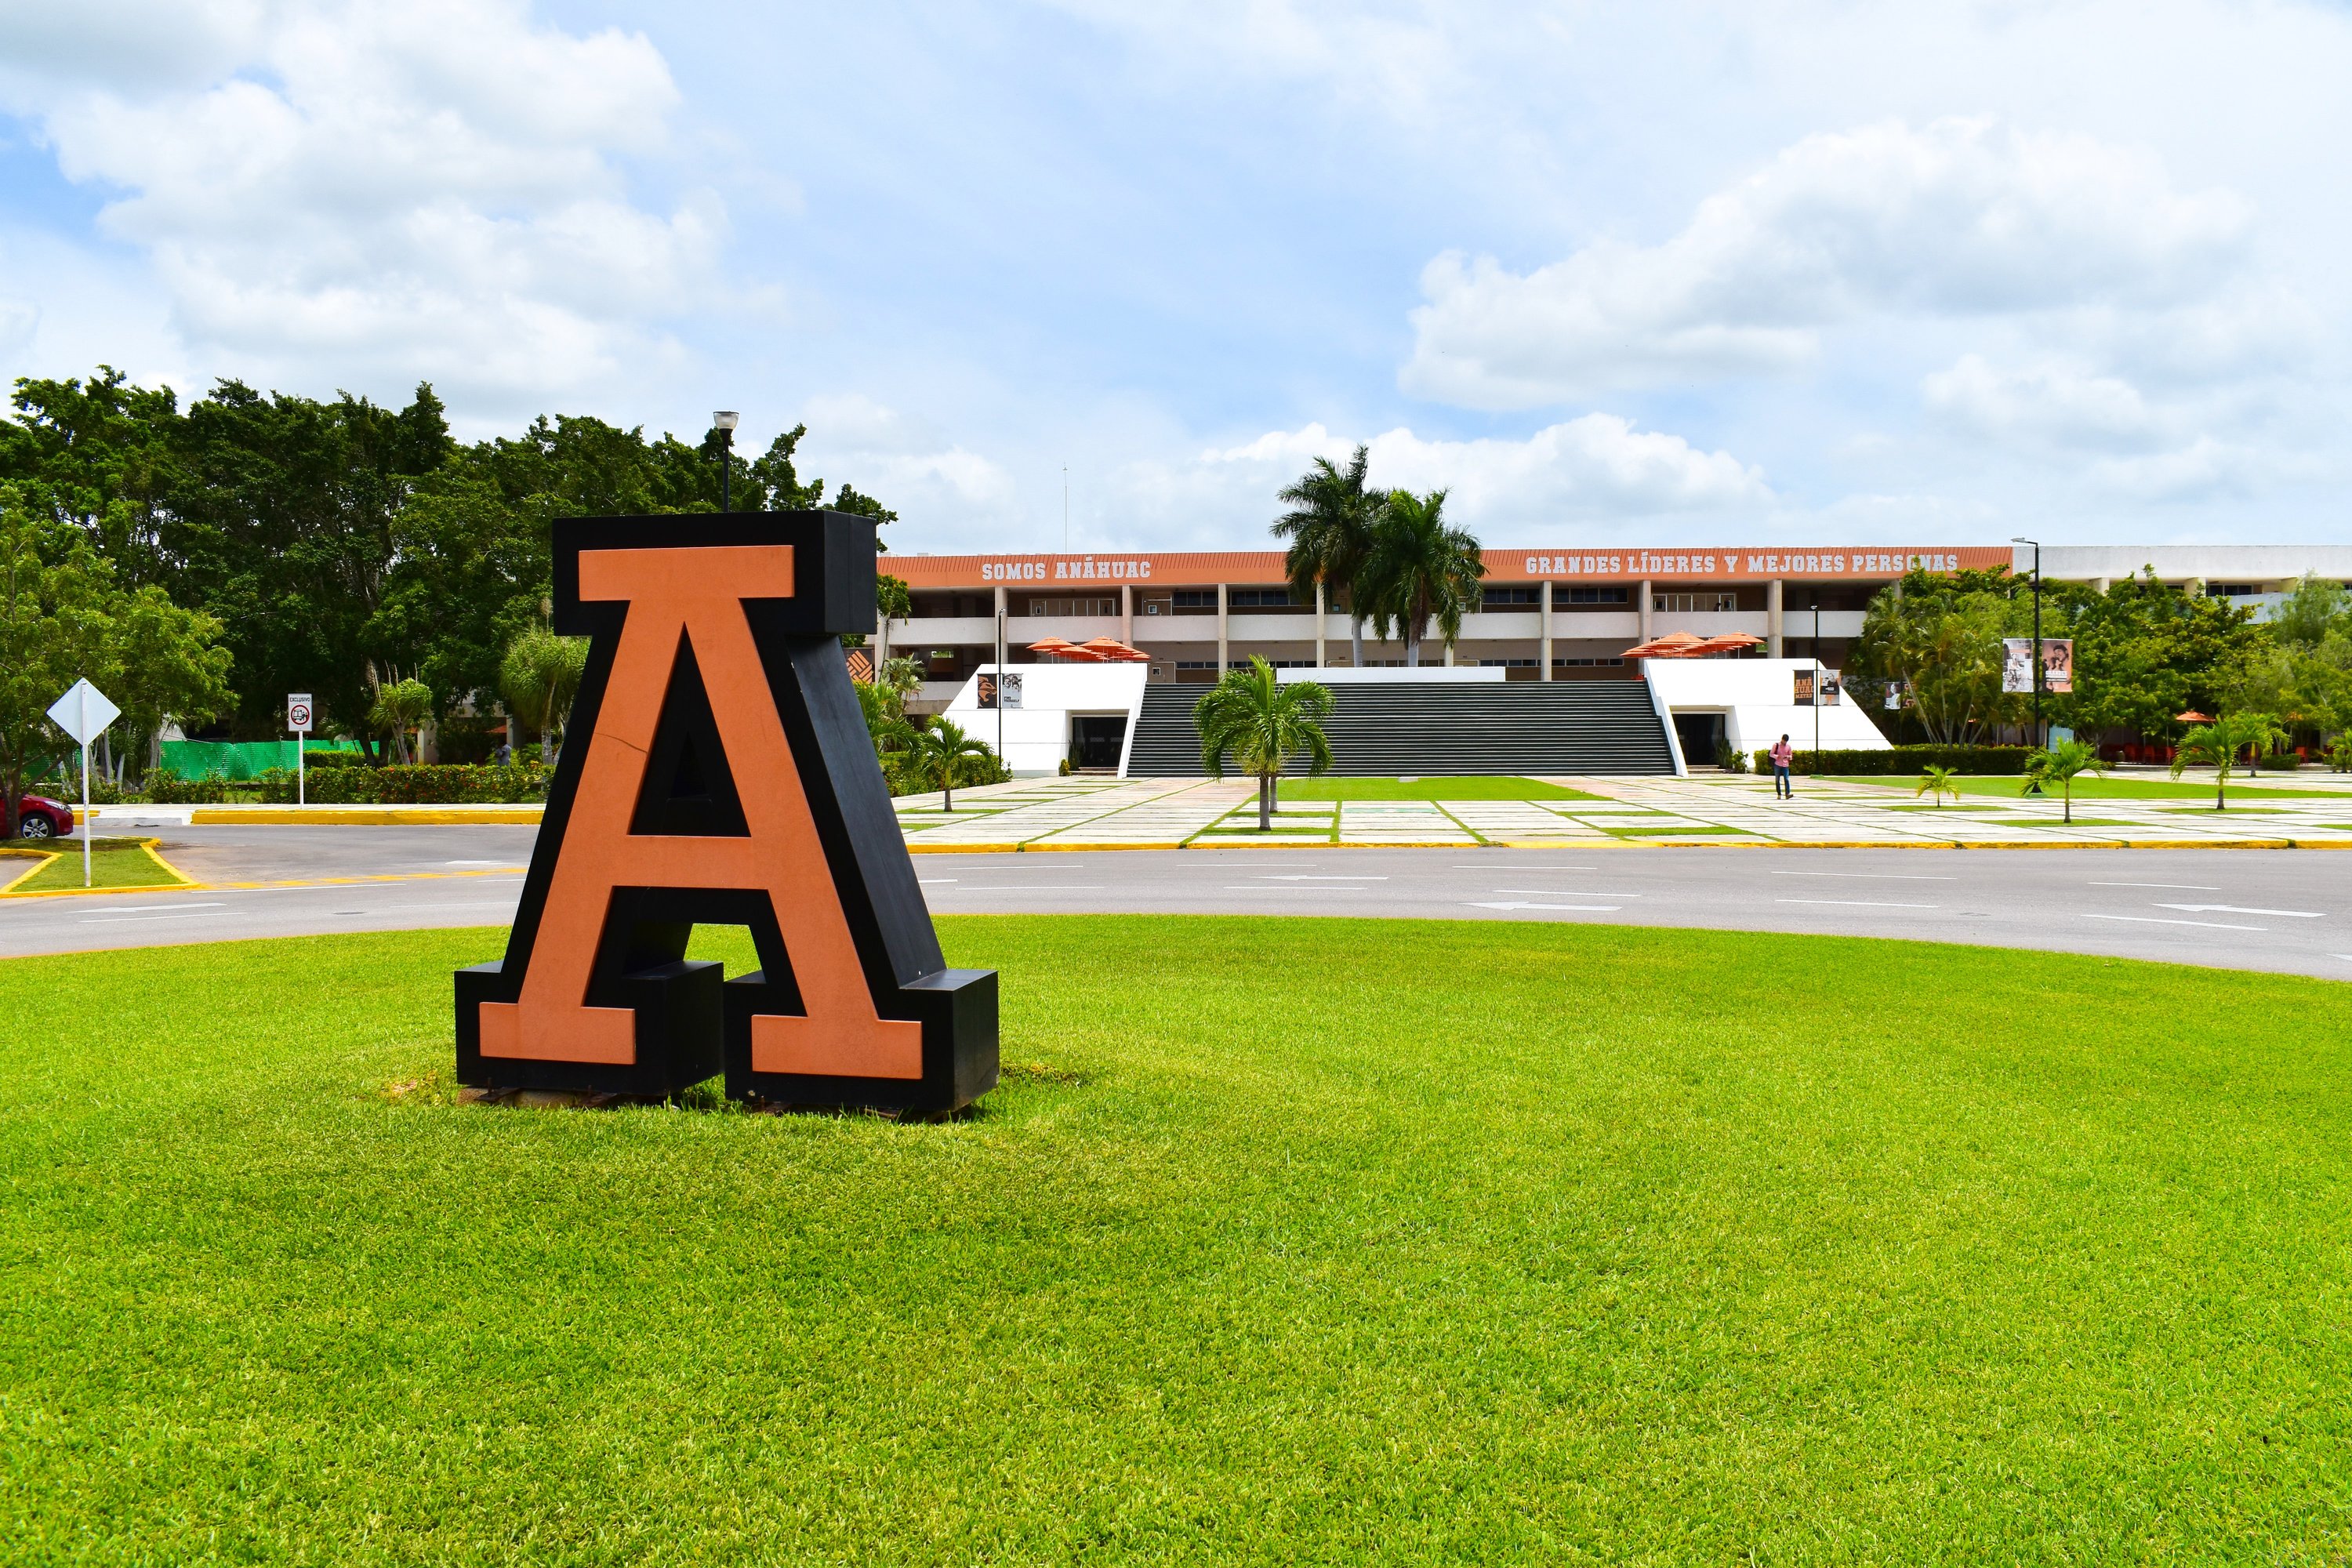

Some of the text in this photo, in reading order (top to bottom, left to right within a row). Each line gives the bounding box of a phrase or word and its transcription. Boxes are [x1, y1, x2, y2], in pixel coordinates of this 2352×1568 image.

[982, 556, 1151, 580] SOMOS ANÁHUAC
[1526, 551, 1958, 574] GRANDES LÍDERES Y MEJORES PERSONAS
[477, 545, 922, 1080] A
